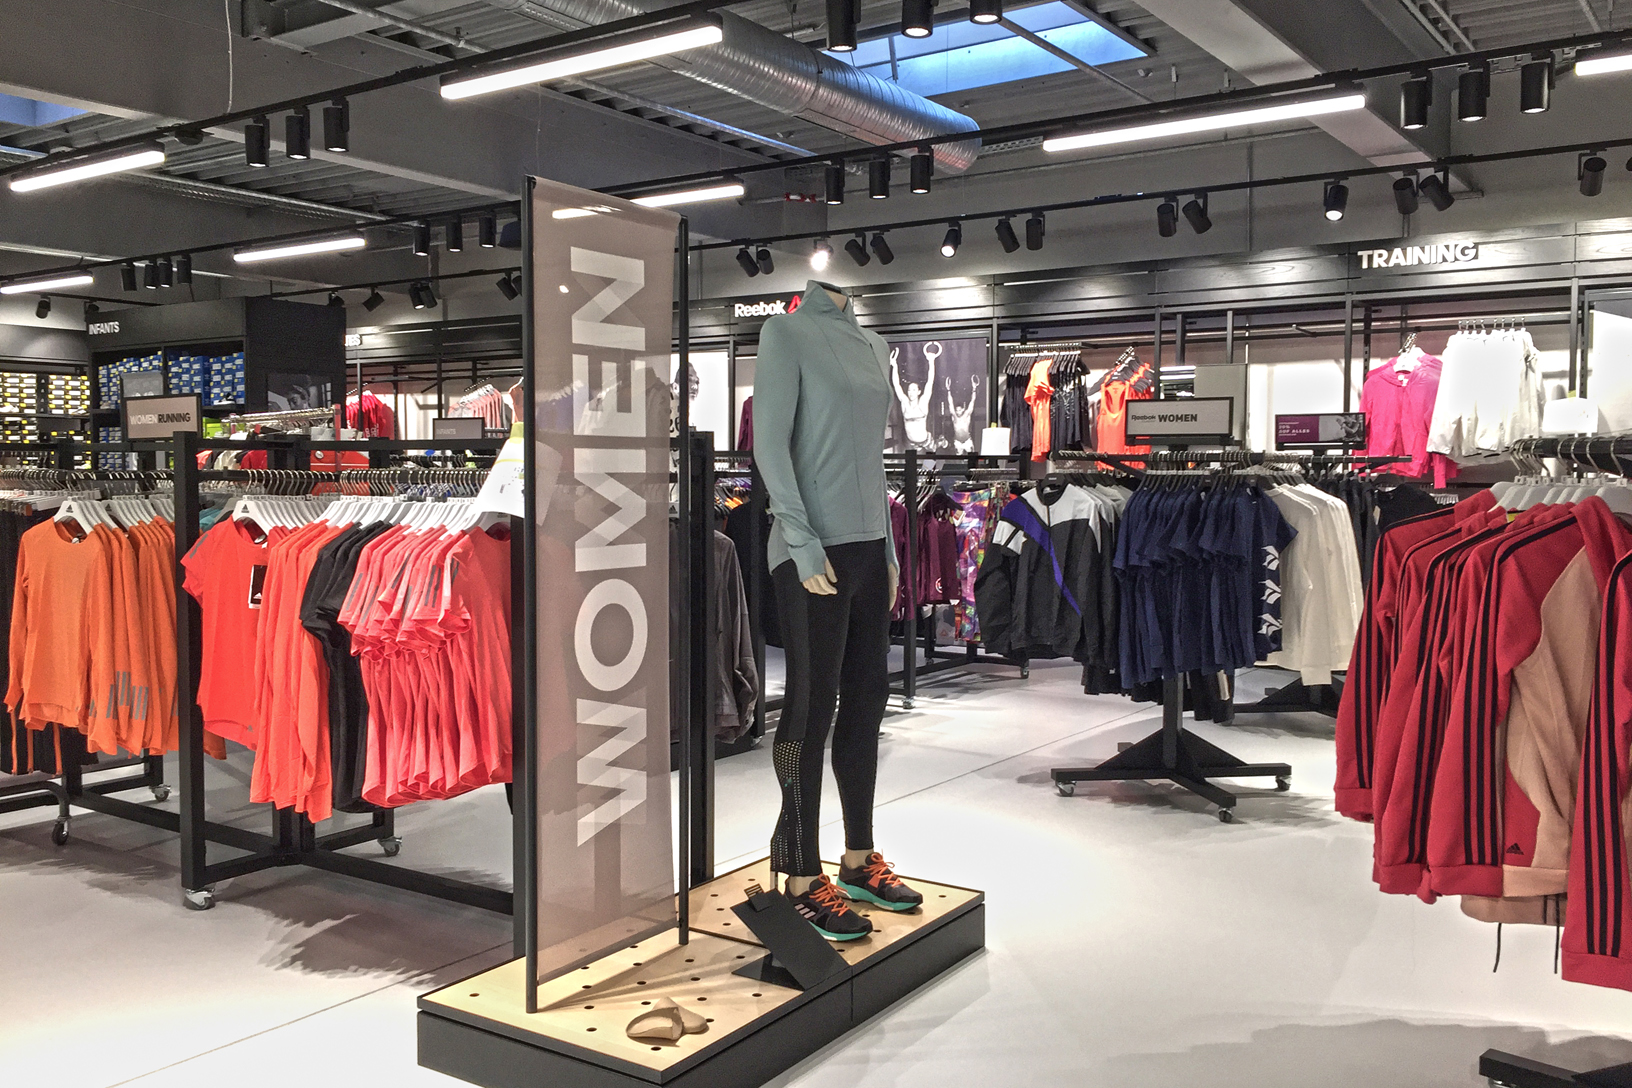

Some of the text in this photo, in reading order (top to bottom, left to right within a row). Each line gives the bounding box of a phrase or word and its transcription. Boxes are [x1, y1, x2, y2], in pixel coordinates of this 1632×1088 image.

[1357, 240, 1477, 269] TRAINING
[734, 300, 786, 318] Reebok
[88, 321, 120, 335] INFANTS
[129, 412, 191, 425] WOMEN RUNNING
[1158, 414, 1198, 423] WOMEN
[571, 246, 648, 847] WOMEN
